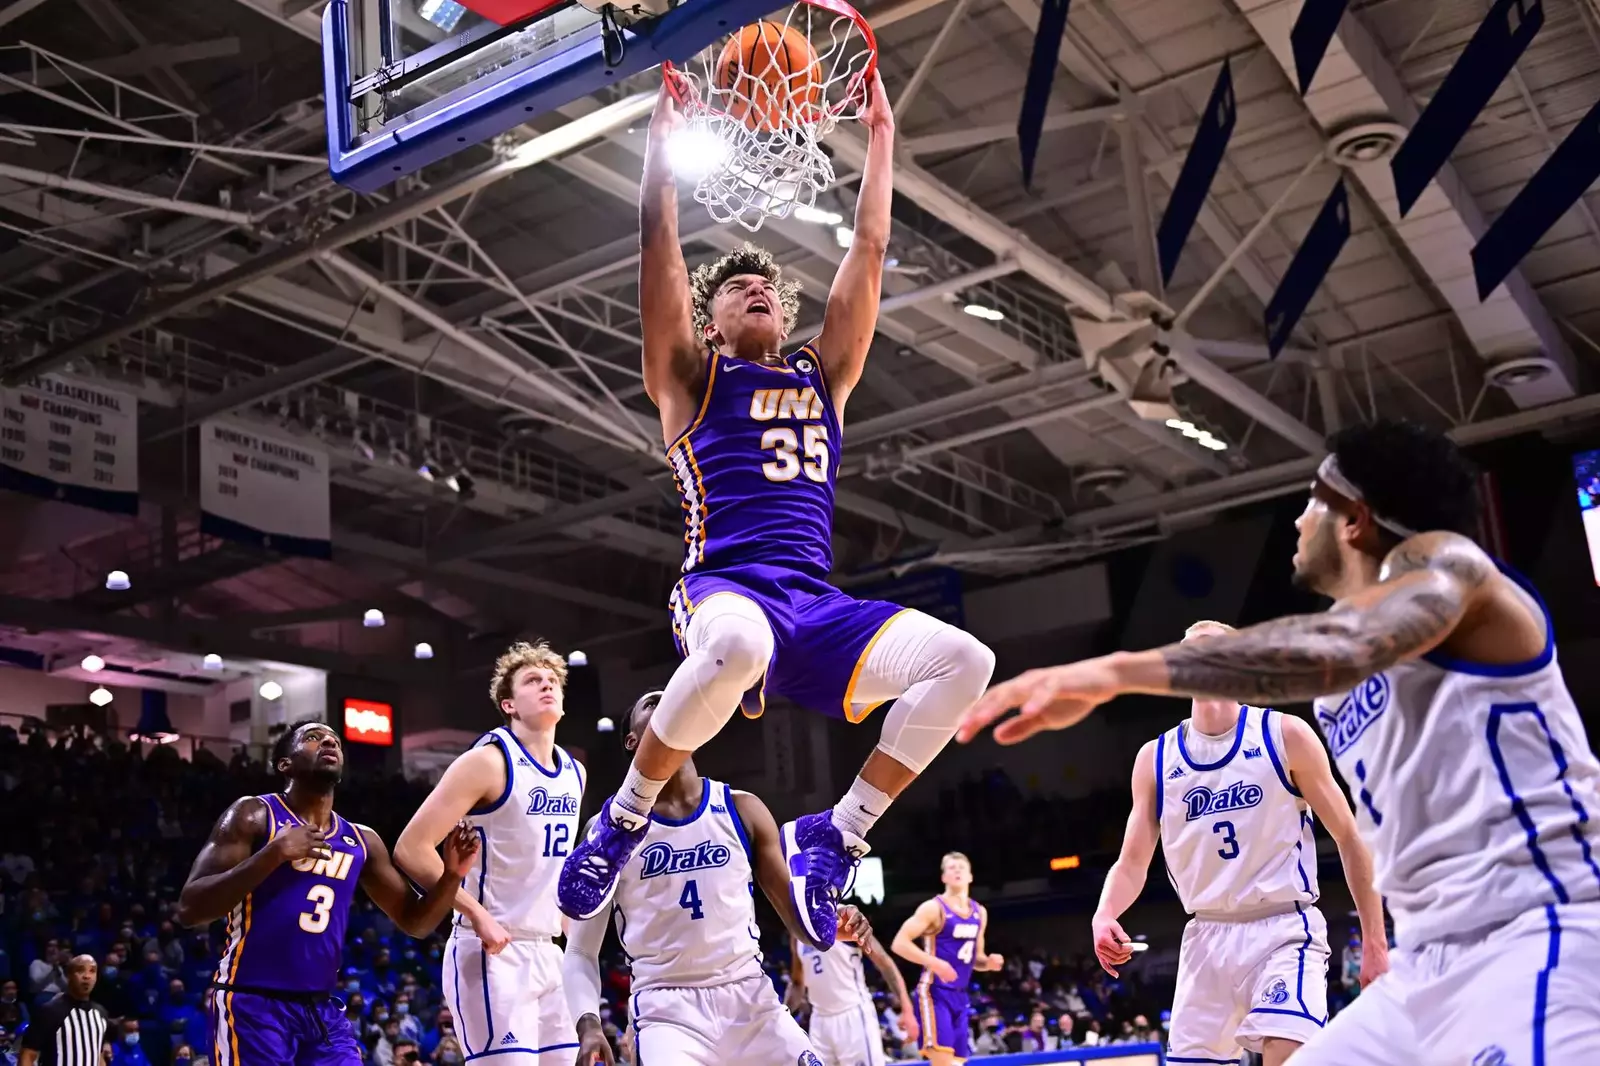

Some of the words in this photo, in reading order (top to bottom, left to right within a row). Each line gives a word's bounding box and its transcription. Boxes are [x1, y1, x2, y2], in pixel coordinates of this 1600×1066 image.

[42, 400, 102, 426] CHAMPIONS
[55, 381, 121, 412] BASKETBALL
[214, 426, 259, 450] WOMEN'S
[261, 440, 316, 467] BASKETBALL
[760, 425, 829, 482] 35
[526, 786, 577, 816] Drake
[1182, 780, 1264, 822] Drake
[542, 823, 569, 857] 12
[640, 840, 731, 880] Drake
[1213, 820, 1240, 860] 3
[299, 884, 335, 933] 3
[679, 879, 704, 920] 4
[812, 955, 823, 974] 2
[956, 940, 975, 964] 4
